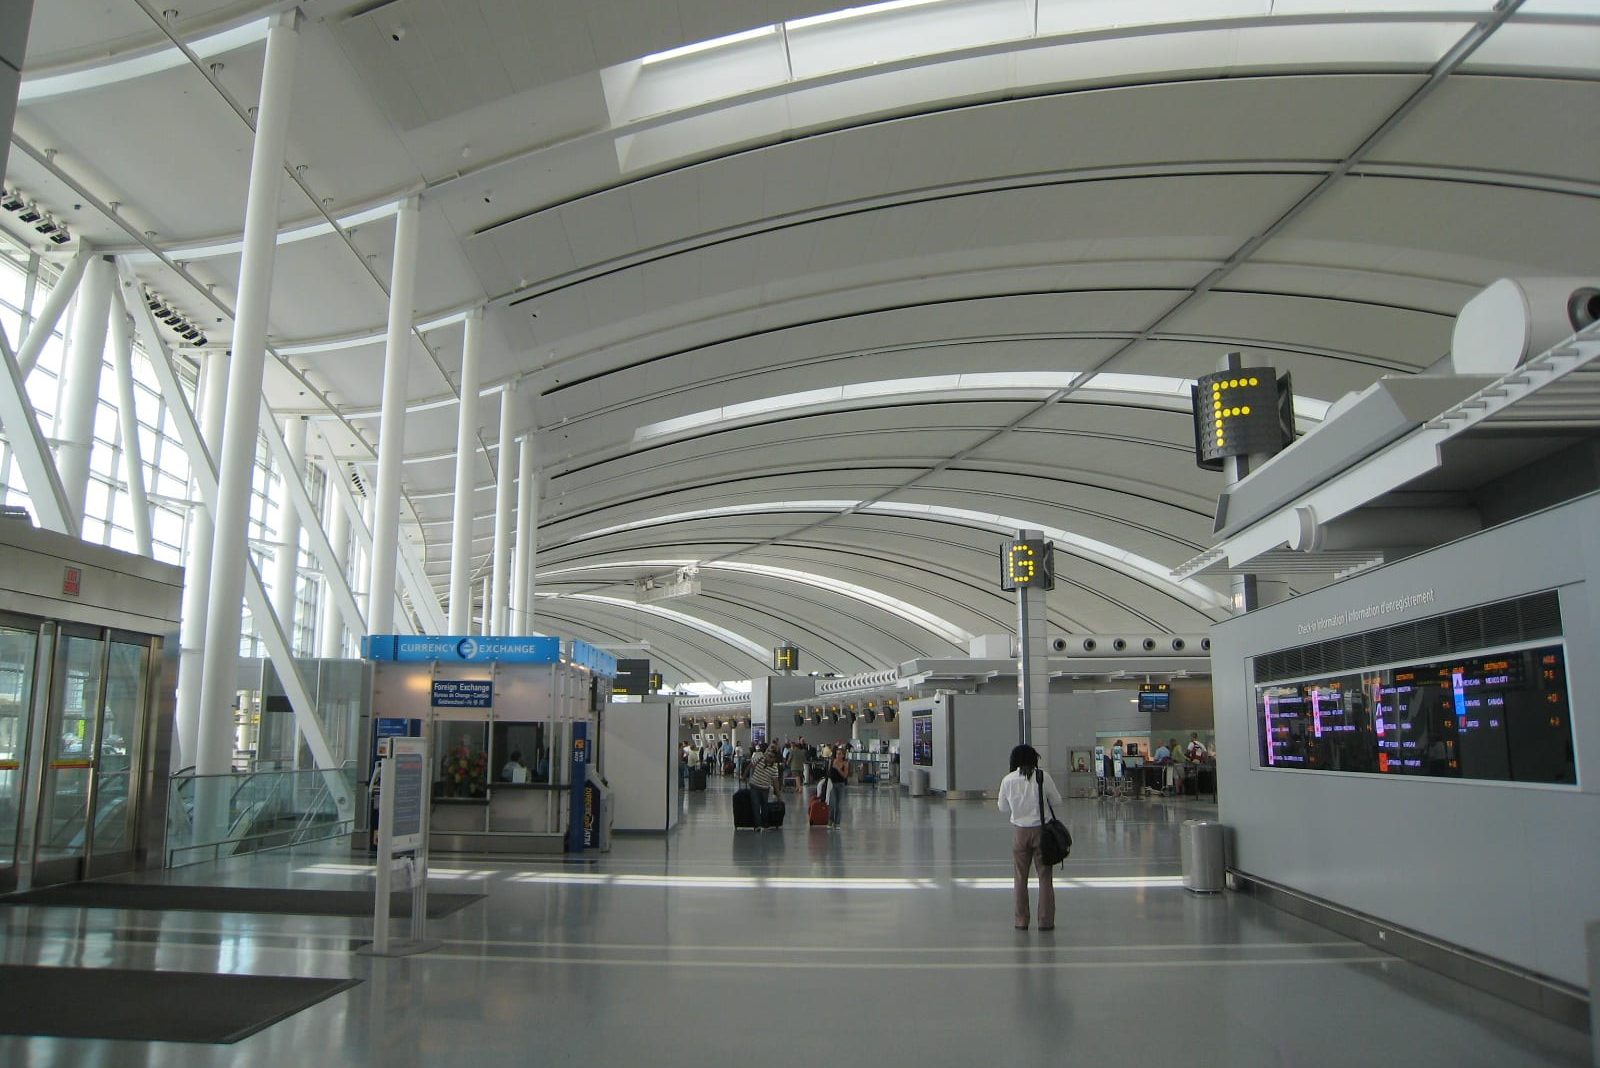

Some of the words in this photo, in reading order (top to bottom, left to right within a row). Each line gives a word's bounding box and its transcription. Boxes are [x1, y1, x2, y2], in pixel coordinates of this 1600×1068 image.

[1212, 378, 1258, 448] F
[1008, 545, 1034, 582] G
[1348, 603, 1380, 622] Information
[1380, 589, 1434, 613] d'enregistrement
[400, 643, 456, 653] CURRENCY
[479, 644, 536, 654] EXCHANGE
[777, 649, 791, 668] H
[434, 682, 457, 692] Foreign
[460, 683, 490, 693] Exchange
